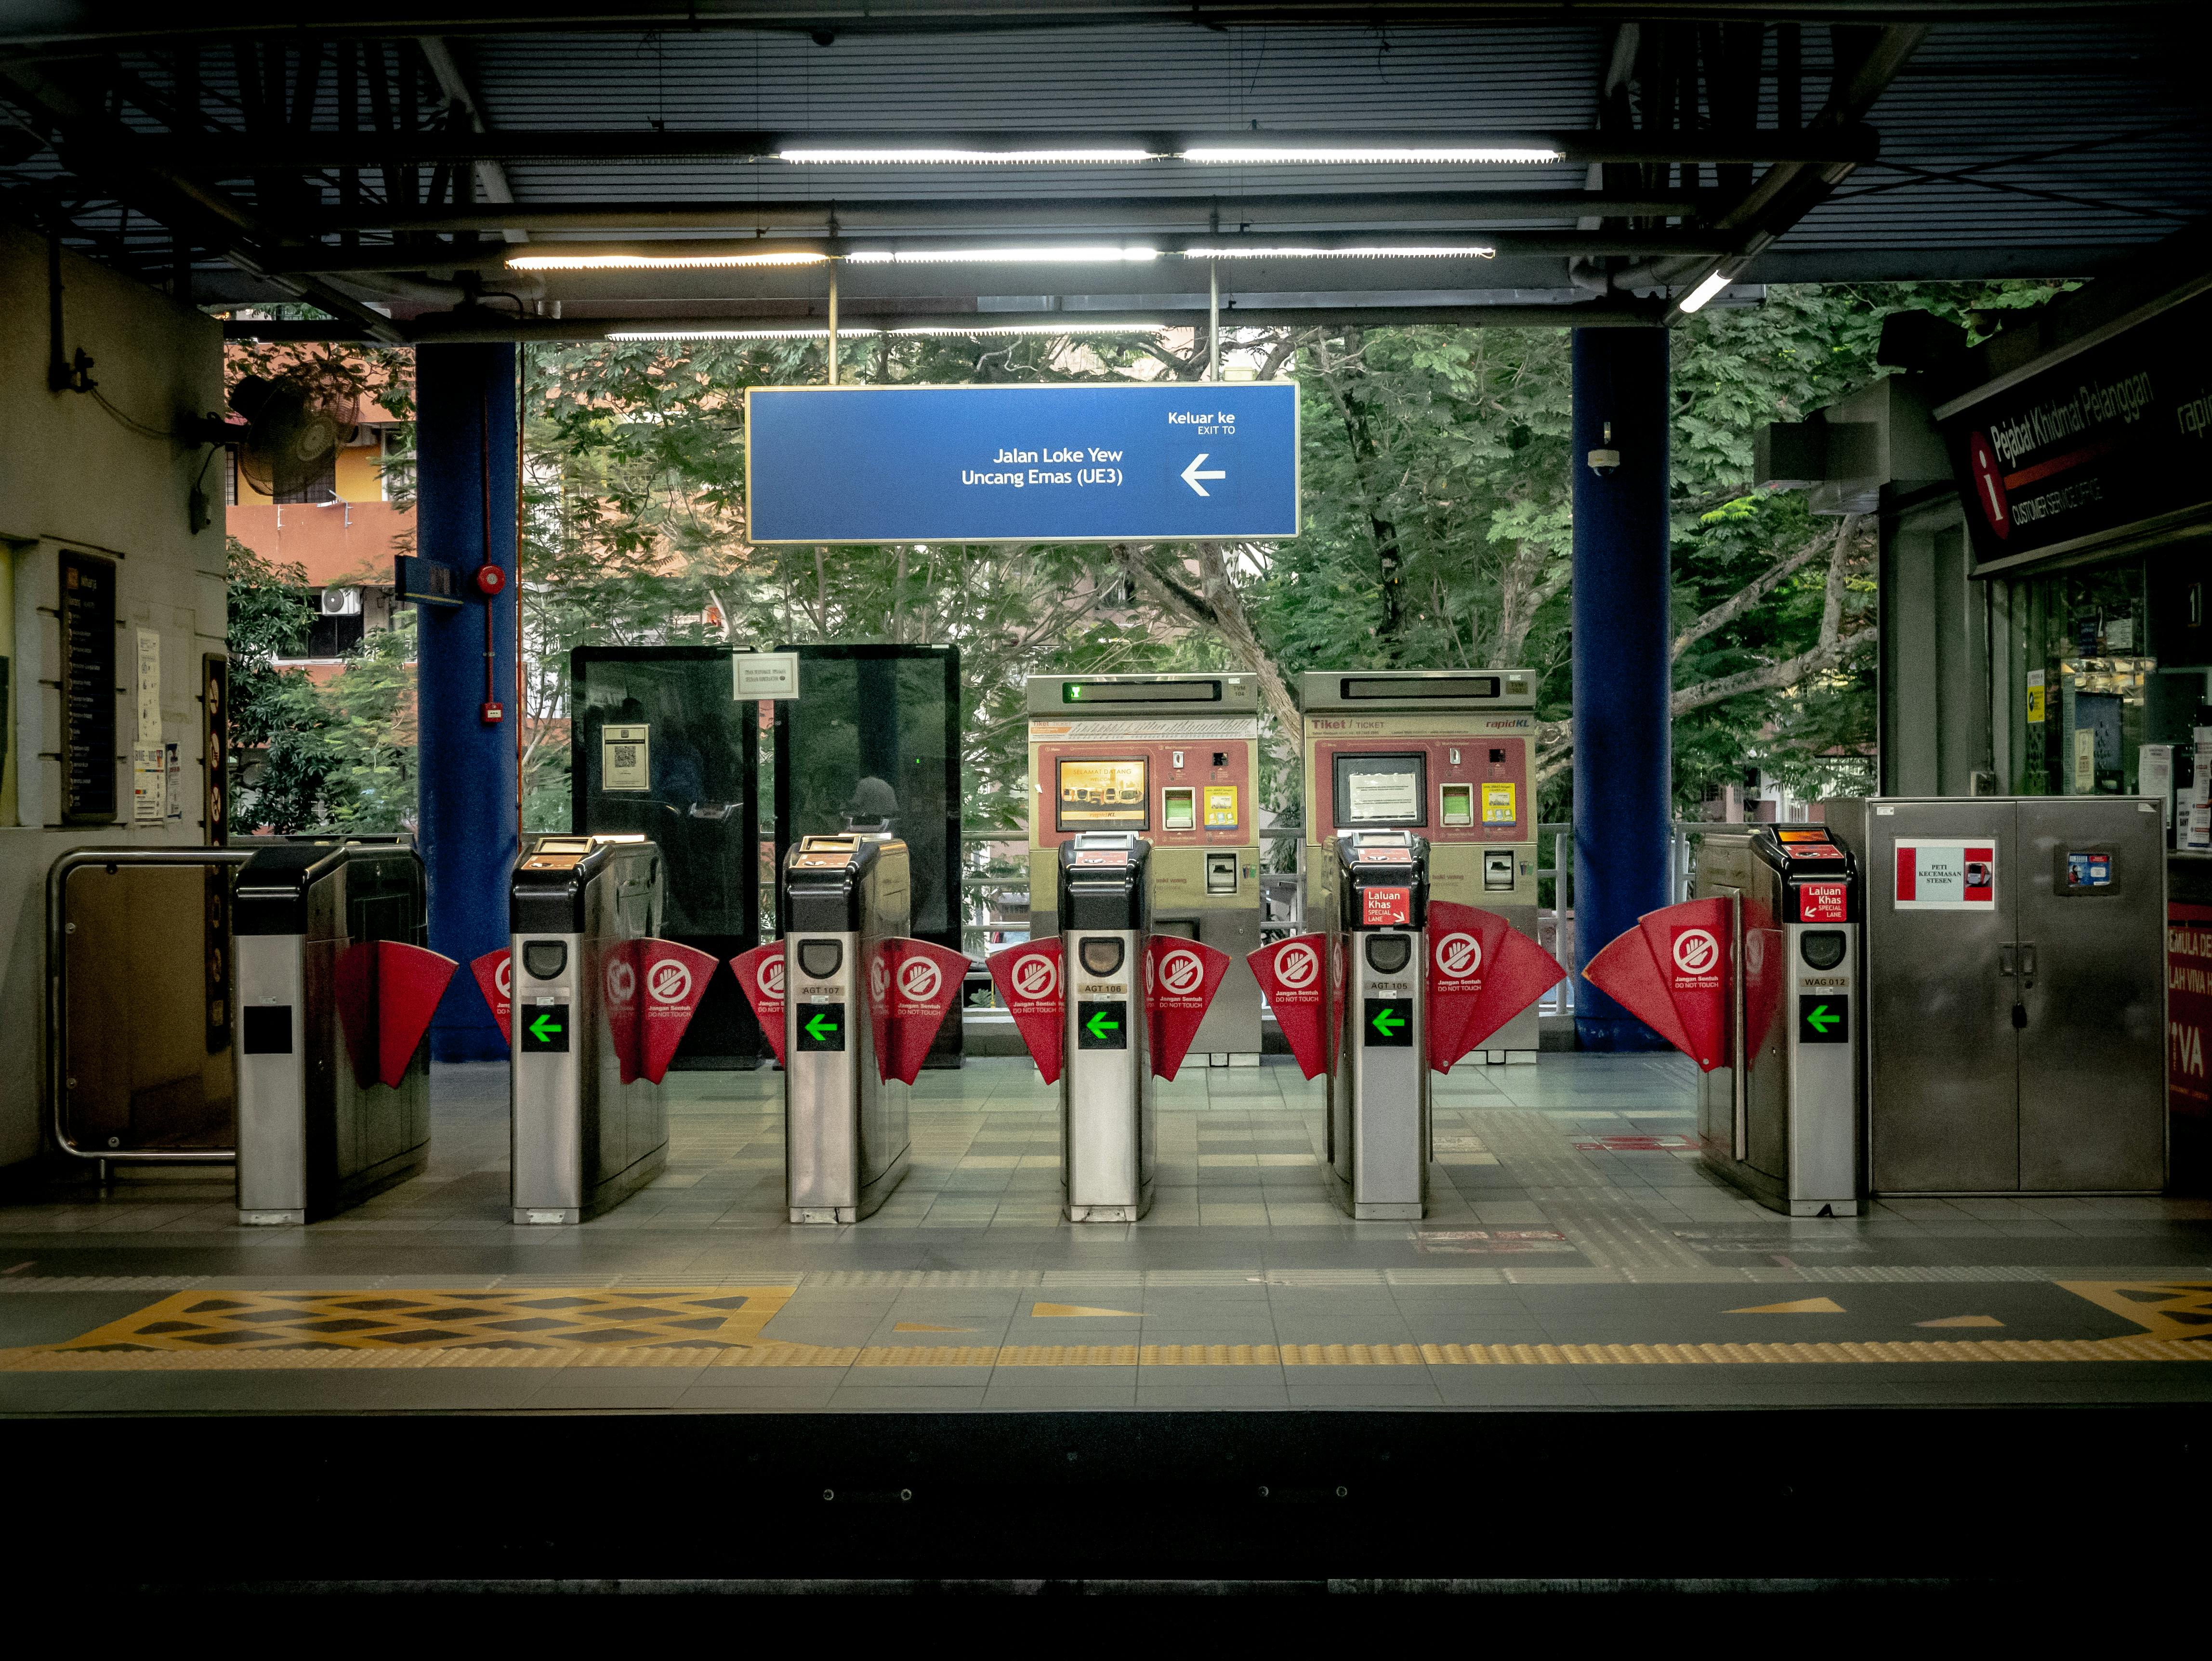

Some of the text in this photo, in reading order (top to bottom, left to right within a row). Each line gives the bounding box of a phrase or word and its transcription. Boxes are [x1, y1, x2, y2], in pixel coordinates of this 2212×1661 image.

[1168, 411, 1235, 424] Keluar ke
[1990, 371, 2154, 468] Pejabat Khidmat Pelanggan
[1198, 426, 1235, 435] EXIT TO
[993, 448, 1123, 464] Jalan Loke Yew
[961, 469, 1123, 488] Uncang Emas (UE3)
[2012, 478, 2105, 526] CUSTOMER SERVICE OFFICE
[1312, 719, 1346, 729] Tiket
[1486, 719, 1529, 729] rapidKL
[1369, 891, 1400, 900] Laluan
[1809, 887, 1841, 896] Laluan
[1369, 900, 1391, 909] Khas
[1819, 896, 1842, 904] Khas
